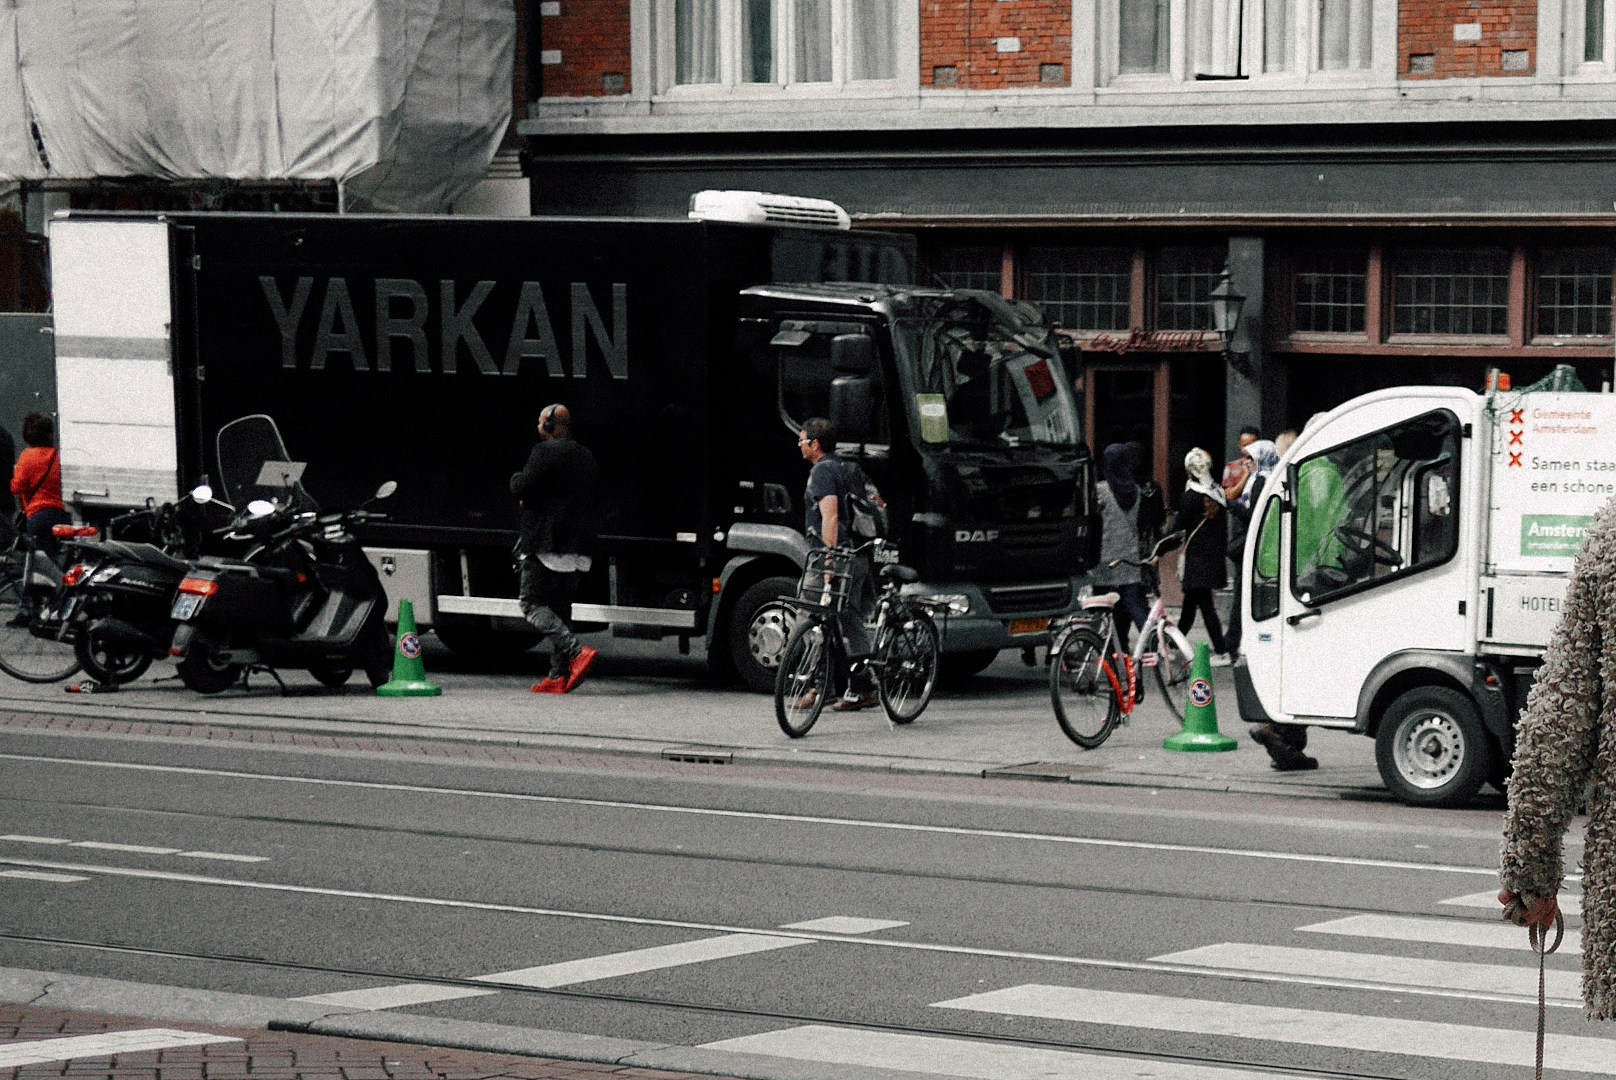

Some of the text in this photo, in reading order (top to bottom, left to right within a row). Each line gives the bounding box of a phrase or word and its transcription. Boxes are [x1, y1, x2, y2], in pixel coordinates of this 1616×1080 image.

[258, 275, 629, 380] YARKAN
[1533, 409, 1592, 420] Gemeente
[1533, 424, 1597, 435] Amsterdam
[1531, 457, 1580, 471] Samen
[1531, 482, 1557, 492] een
[1563, 480, 1614, 494] schone
[955, 530, 999, 542] DAF
